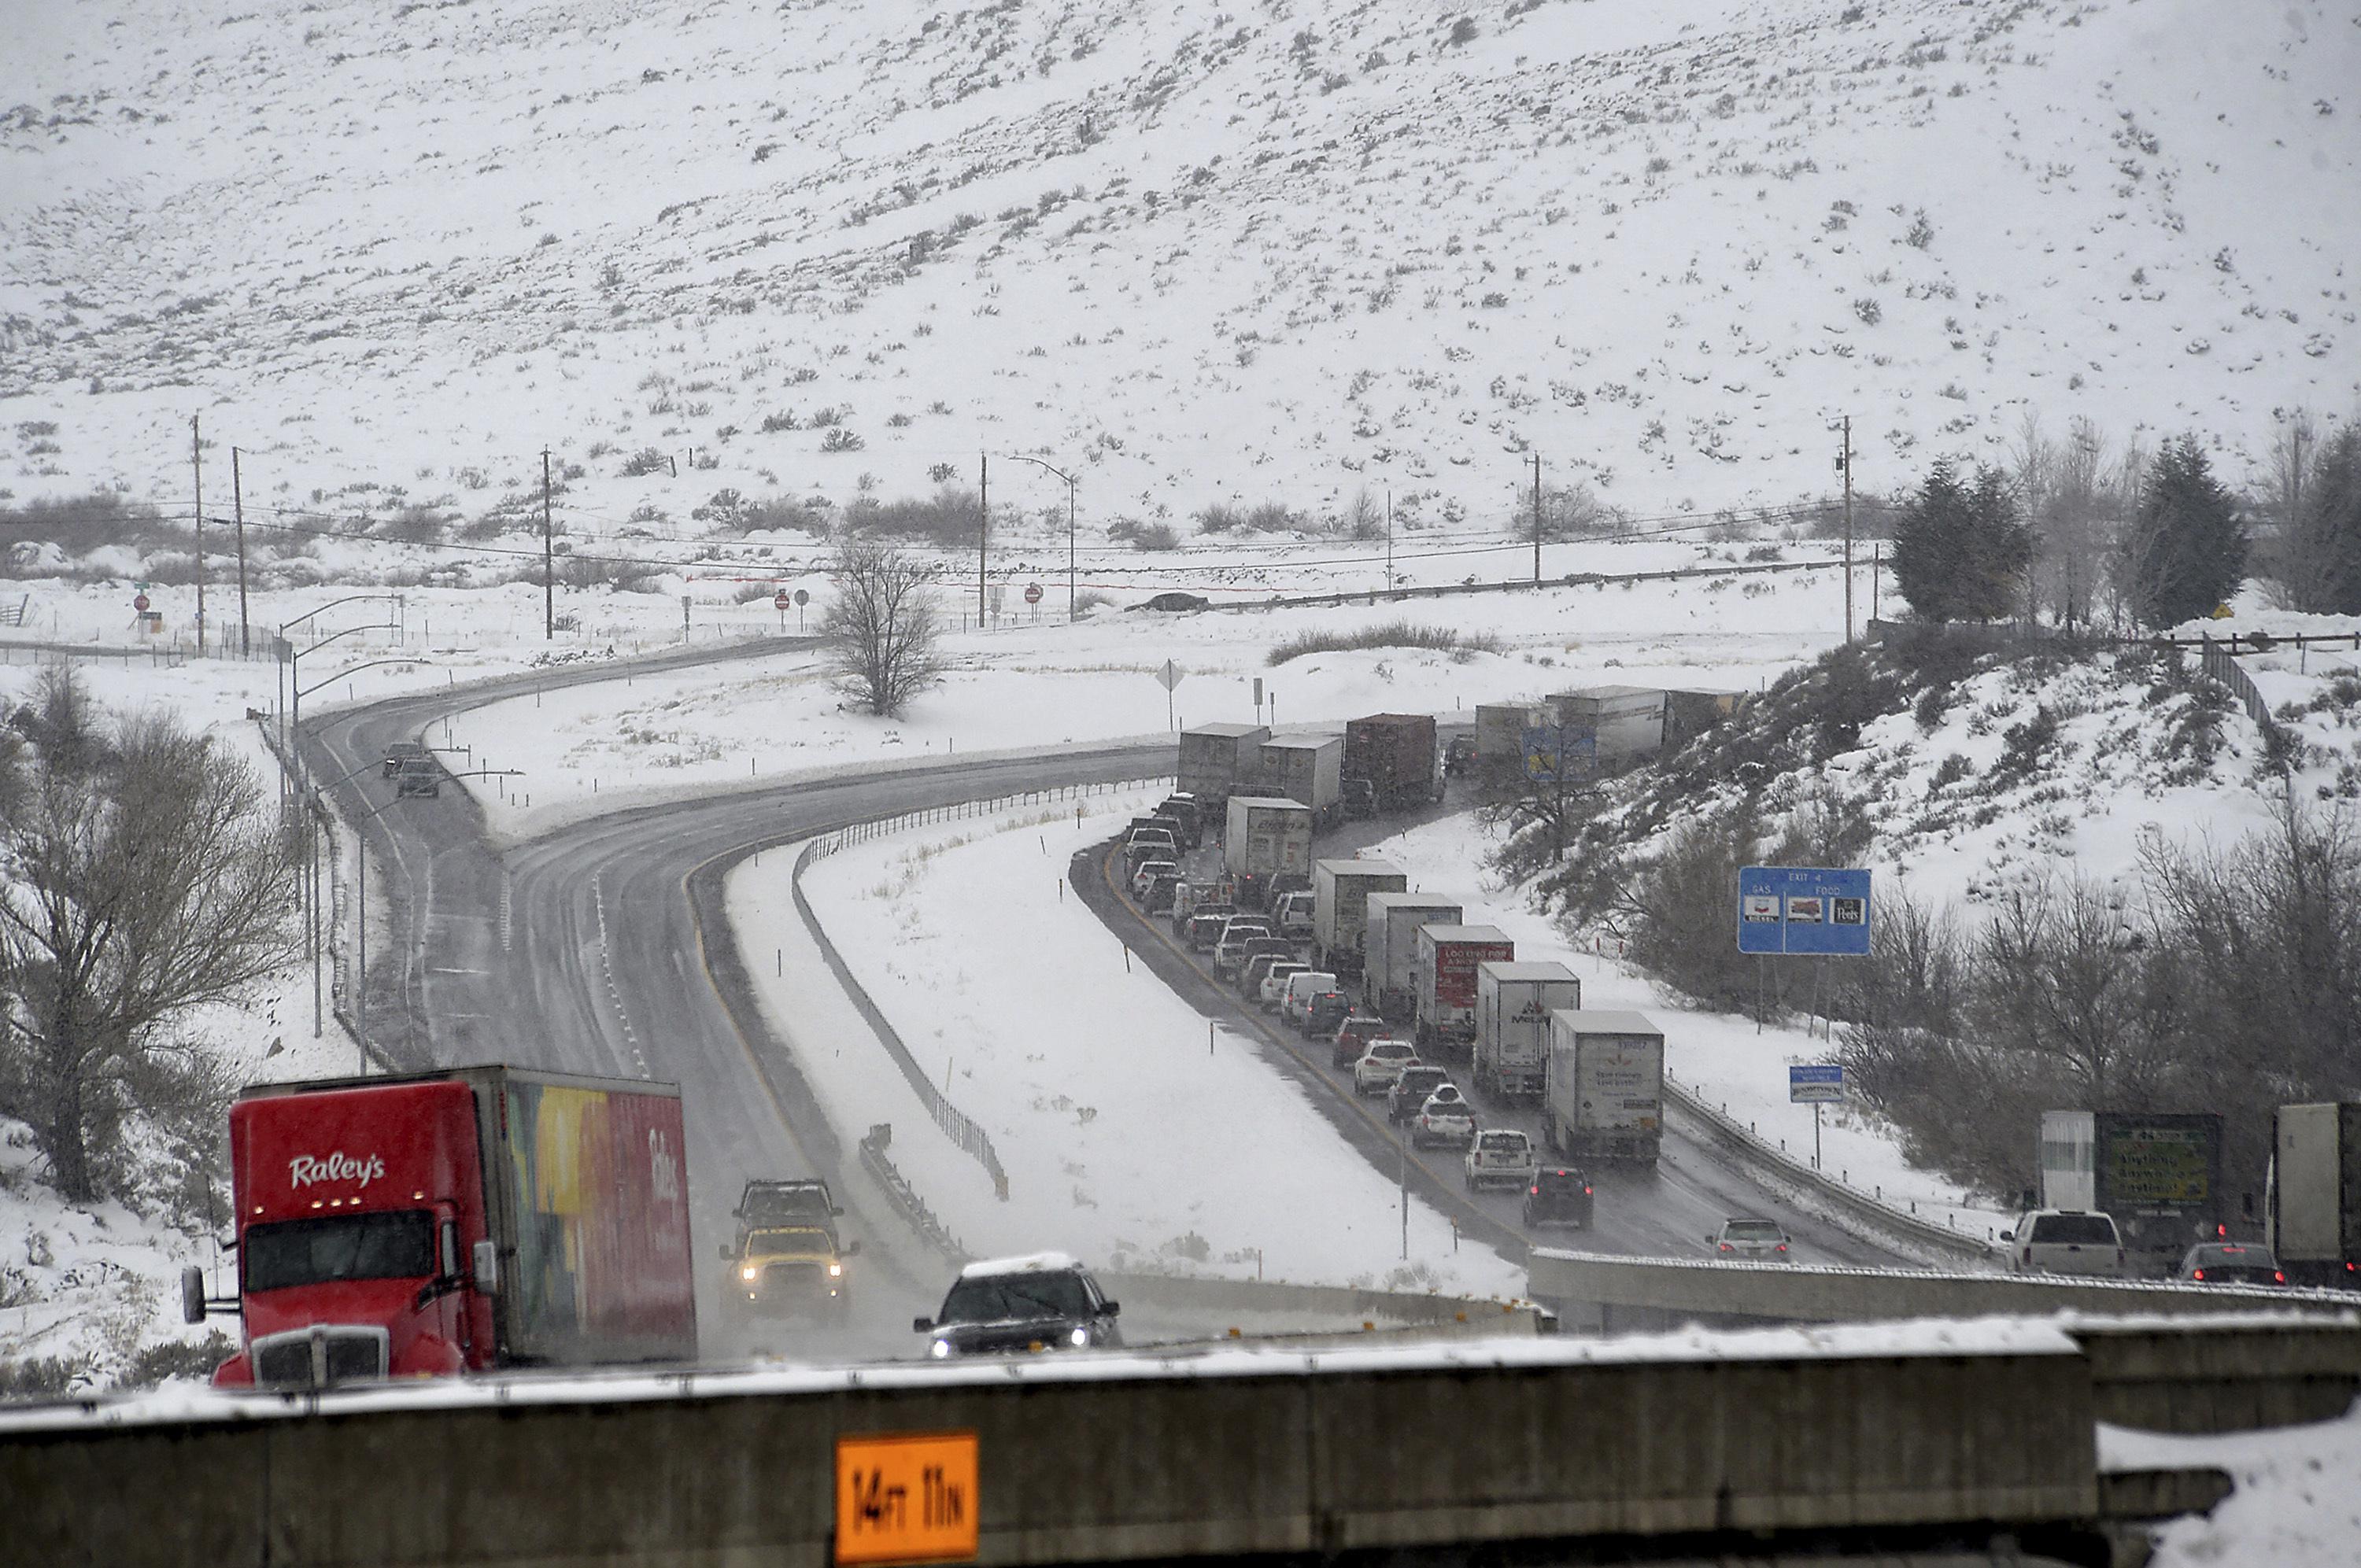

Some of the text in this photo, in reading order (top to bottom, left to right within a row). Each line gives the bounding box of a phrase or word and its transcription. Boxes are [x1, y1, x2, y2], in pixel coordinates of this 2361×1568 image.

[1789, 873, 1808, 882] EXIT
[1752, 885, 1772, 895] GAS
[1816, 887, 1841, 895] FOOD
[288, 1150, 385, 1190] Raley's
